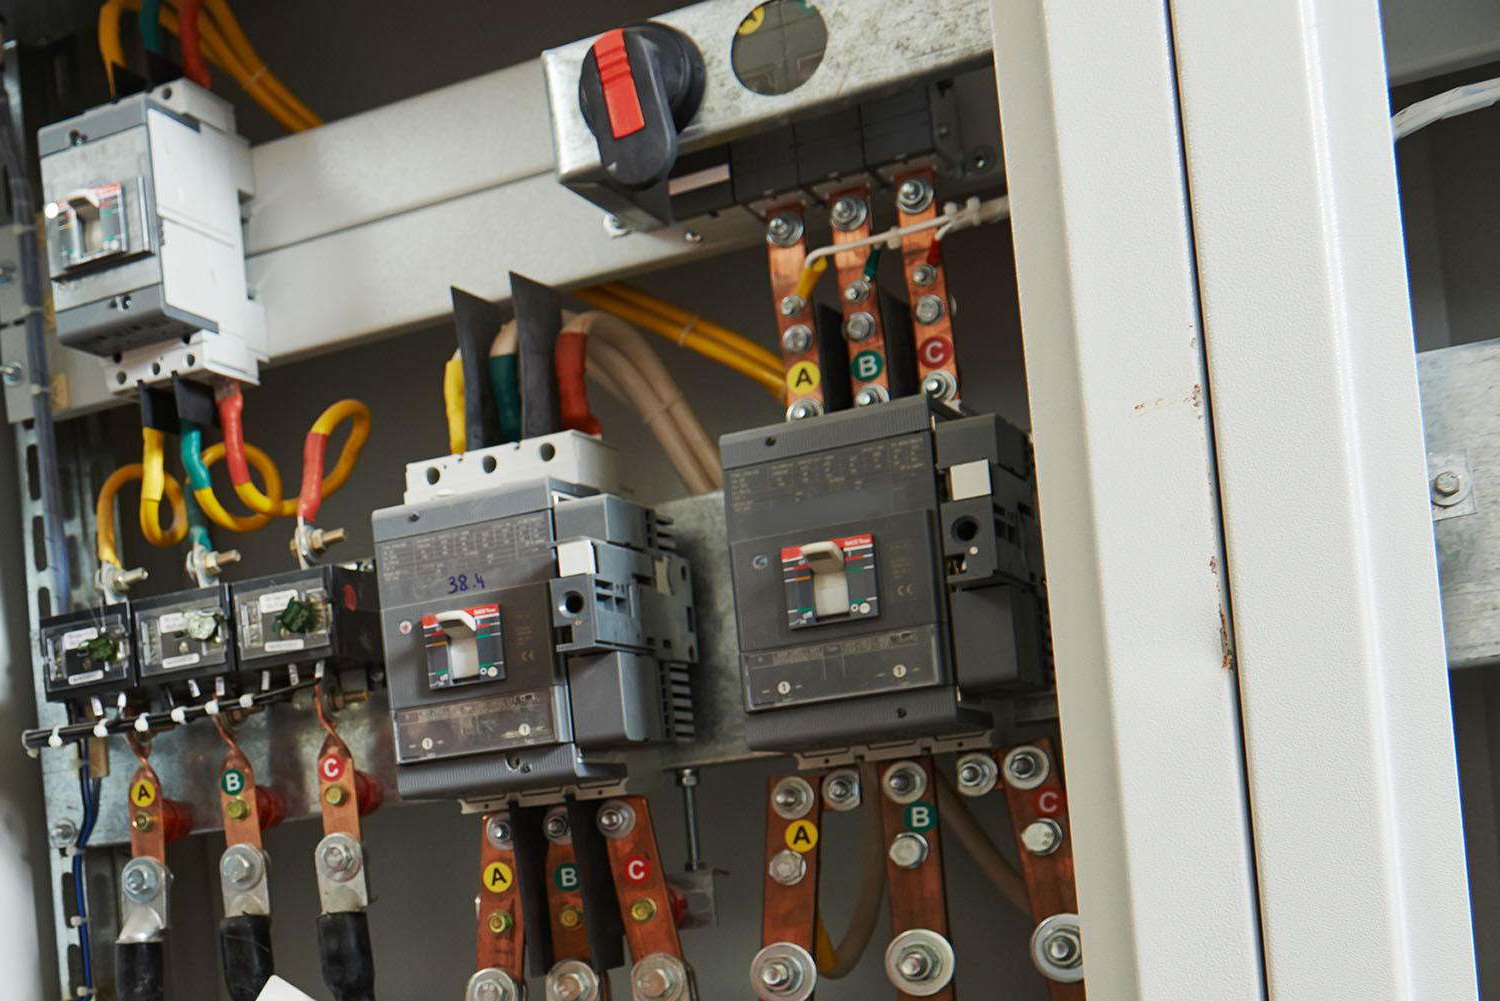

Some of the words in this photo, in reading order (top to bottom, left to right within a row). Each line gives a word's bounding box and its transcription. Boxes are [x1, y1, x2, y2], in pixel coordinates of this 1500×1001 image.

[926, 341, 944, 363] C
[859, 355, 878, 377] B
[795, 367, 813, 387] A
[448, 573, 485, 594] 38.4
[324, 758, 338, 777] C
[226, 772, 240, 791] B
[137, 784, 151, 801] A
[1039, 792, 1058, 812] C
[911, 807, 930, 827] B
[793, 825, 810, 844] A
[492, 868, 506, 885] A
[561, 867, 577, 887] B
[629, 860, 645, 880] C
